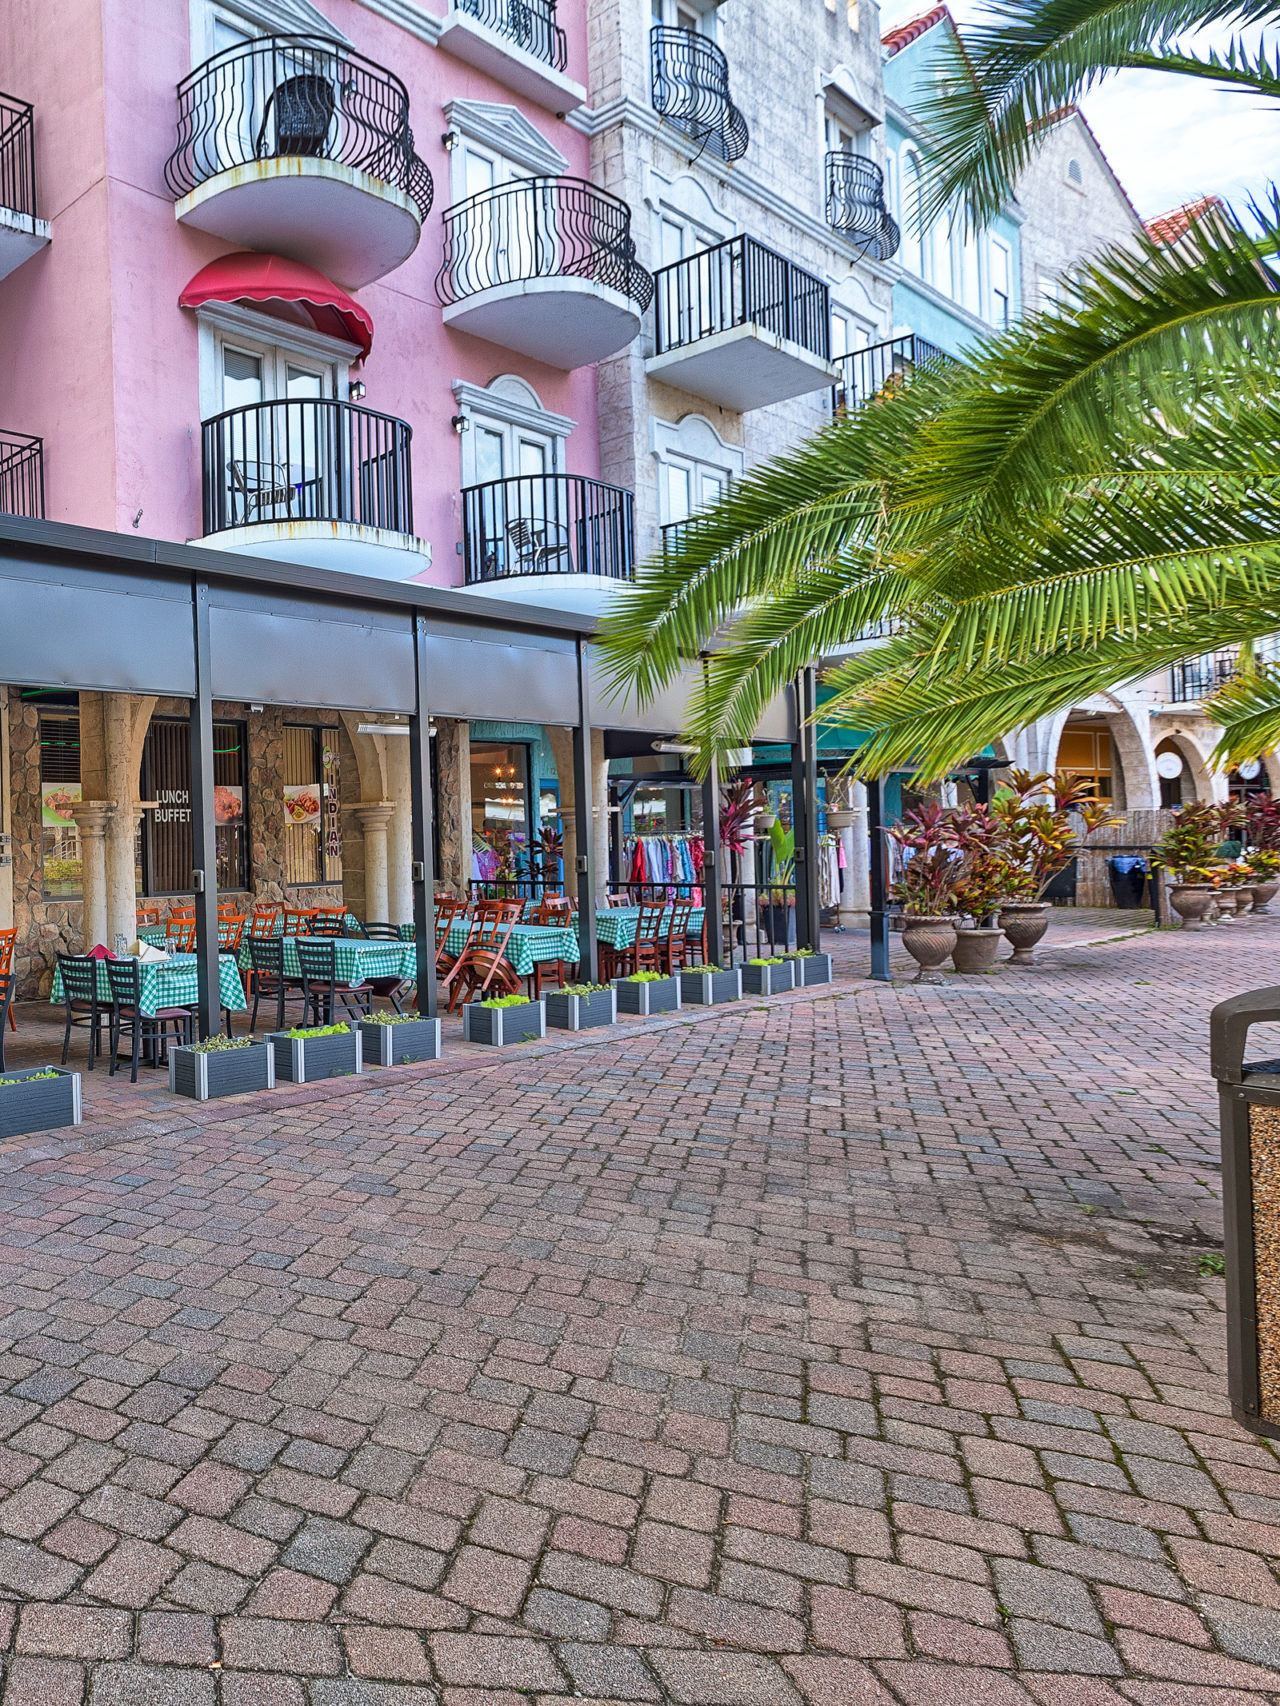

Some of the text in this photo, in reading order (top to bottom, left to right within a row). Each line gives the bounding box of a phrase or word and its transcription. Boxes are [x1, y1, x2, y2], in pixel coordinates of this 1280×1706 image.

[156, 789, 189, 804] LUNCH
[154, 808, 191, 823] BUFFET
[328, 772, 339, 857] INDIAN
